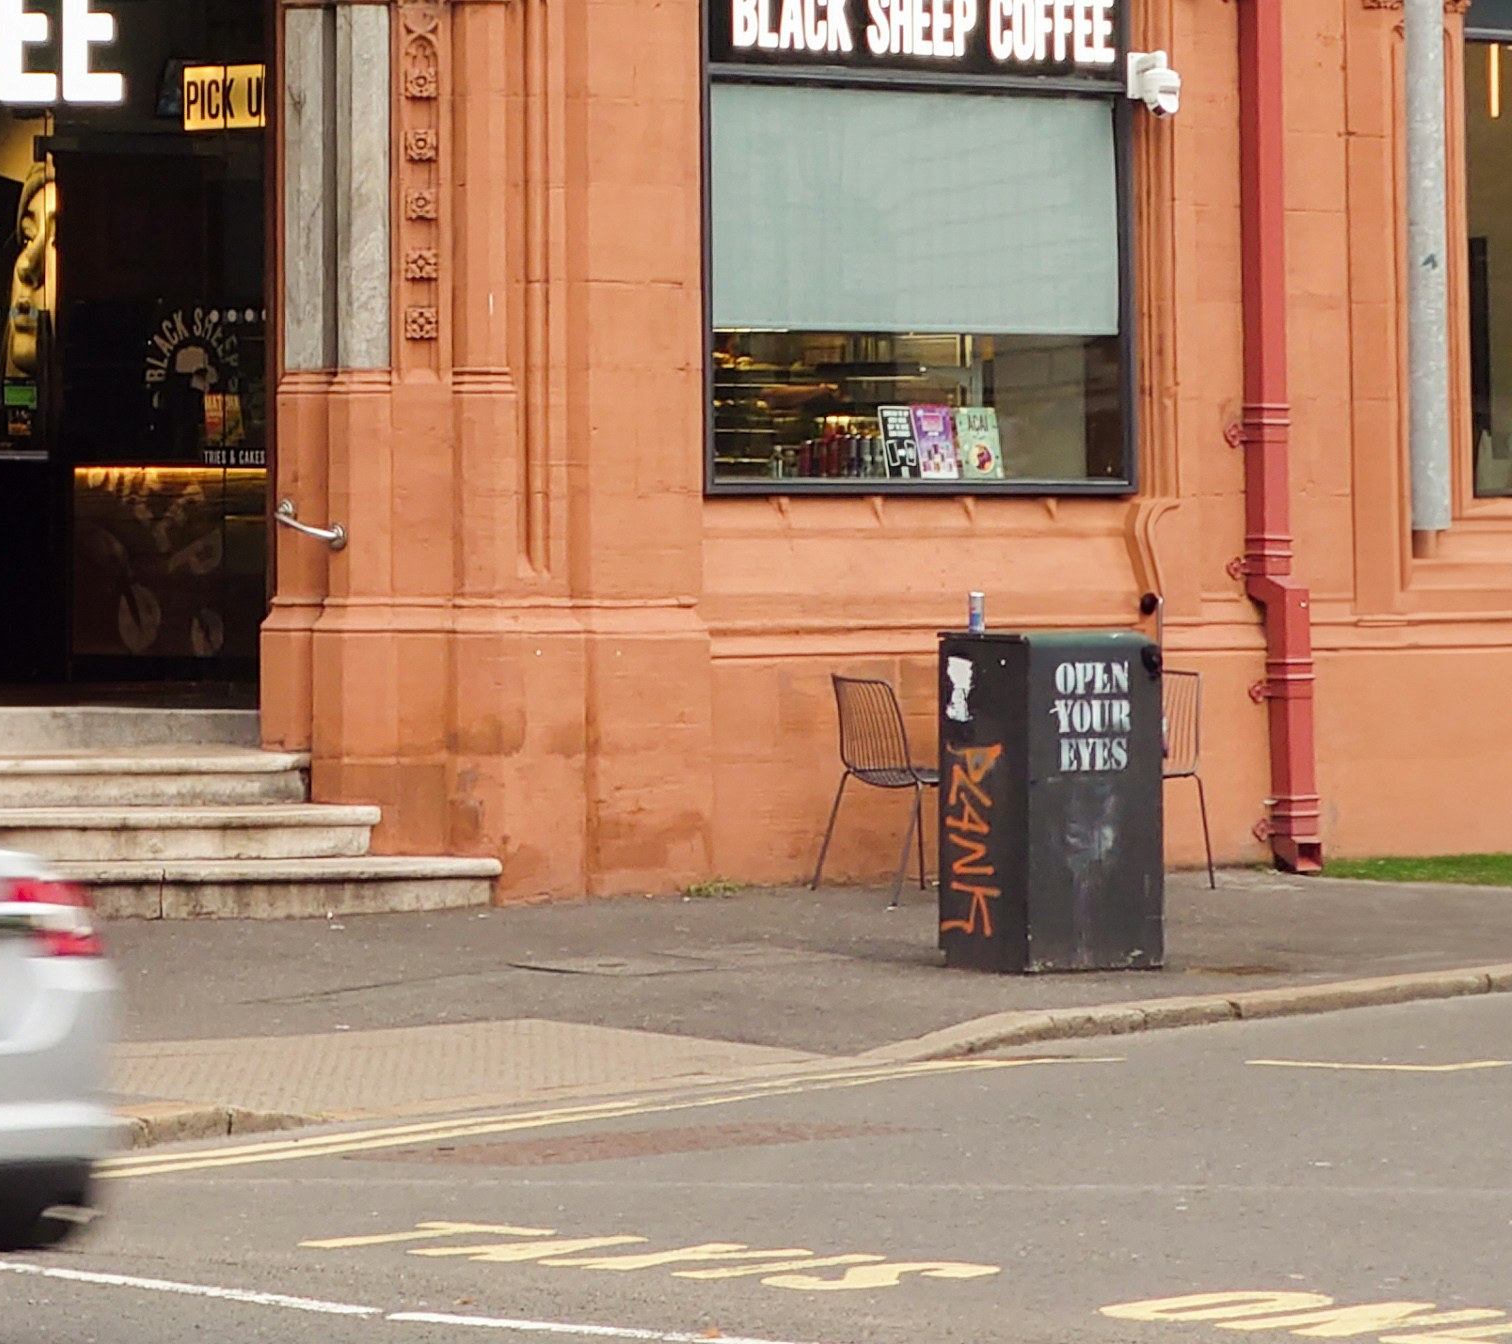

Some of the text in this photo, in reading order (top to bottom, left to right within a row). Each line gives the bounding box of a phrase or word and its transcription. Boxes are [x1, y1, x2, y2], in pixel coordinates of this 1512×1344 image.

[186, 77, 235, 120] PICK
[145, 307, 239, 382] BLACK SHEEP
[239, 449, 265, 465] CAKES
[1055, 661, 1129, 695] OPEN
[1051, 699, 1131, 733] YOUR
[1060, 738, 1128, 773] EYES
[297, 1221, 1001, 1290] TAXIS
